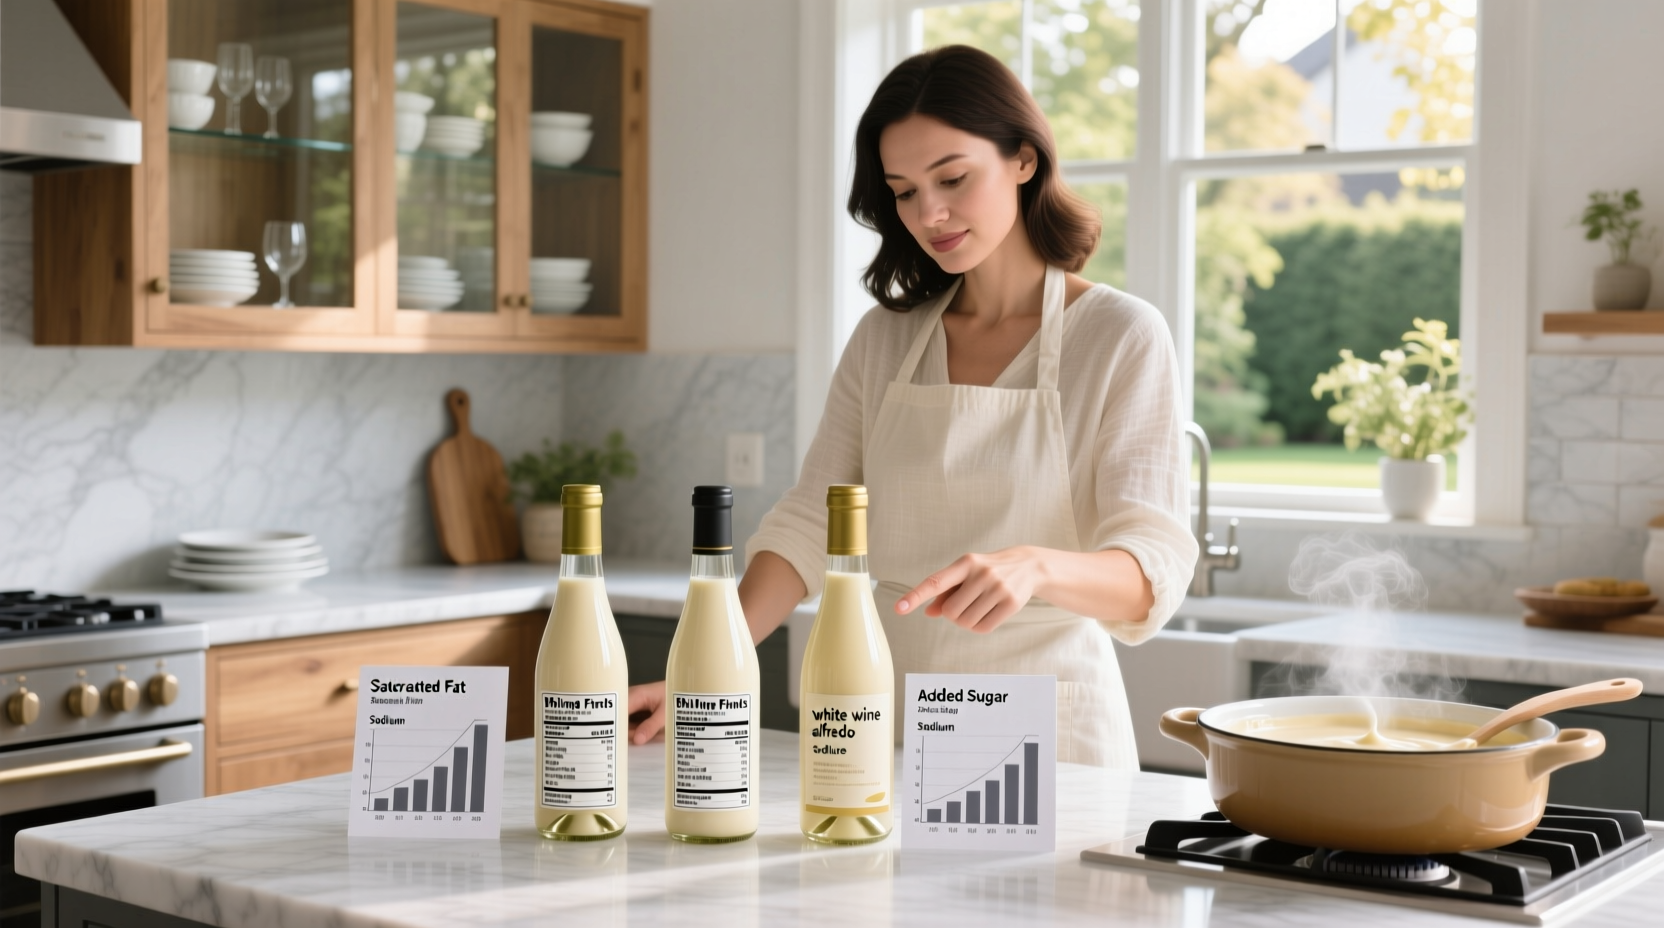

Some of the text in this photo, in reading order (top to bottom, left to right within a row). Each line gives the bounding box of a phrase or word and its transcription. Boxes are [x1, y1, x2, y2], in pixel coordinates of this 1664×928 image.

[445, 679, 466, 693] Fat
[918, 687, 1008, 706] Added Sugar
[812, 706, 881, 721] white wine
[812, 722, 855, 738] alfredo
